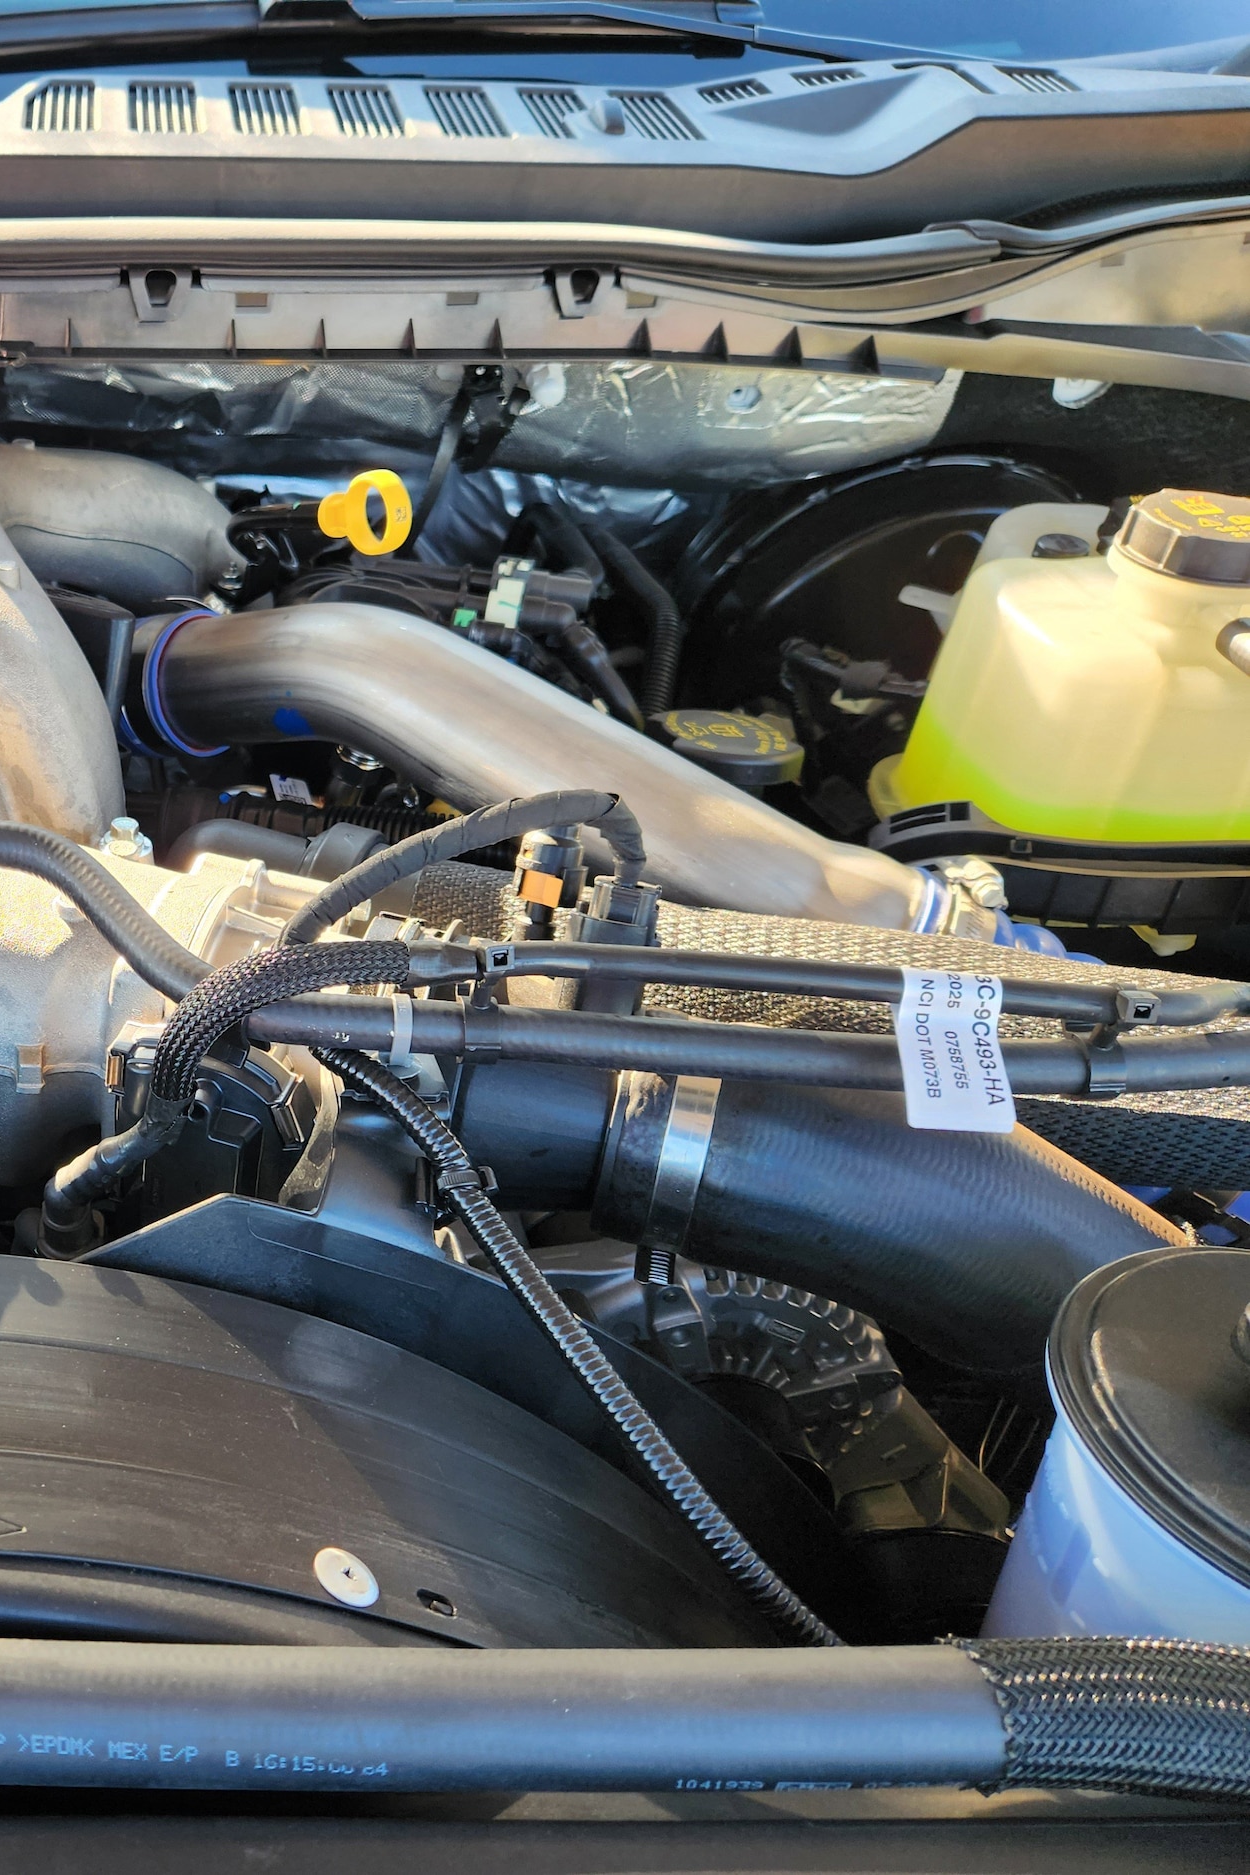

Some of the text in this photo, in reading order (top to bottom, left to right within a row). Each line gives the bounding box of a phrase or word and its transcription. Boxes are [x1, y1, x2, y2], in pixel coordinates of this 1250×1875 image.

[915, 979, 942, 1098] NCI DOT M073B
[944, 973, 969, 1089] 2025 0758755
[107, 1738, 149, 1763] MEX
[158, 1744, 199, 1765] E/P
[224, 1749, 241, 1768] B
[675, 1778, 765, 1790] 1041939
